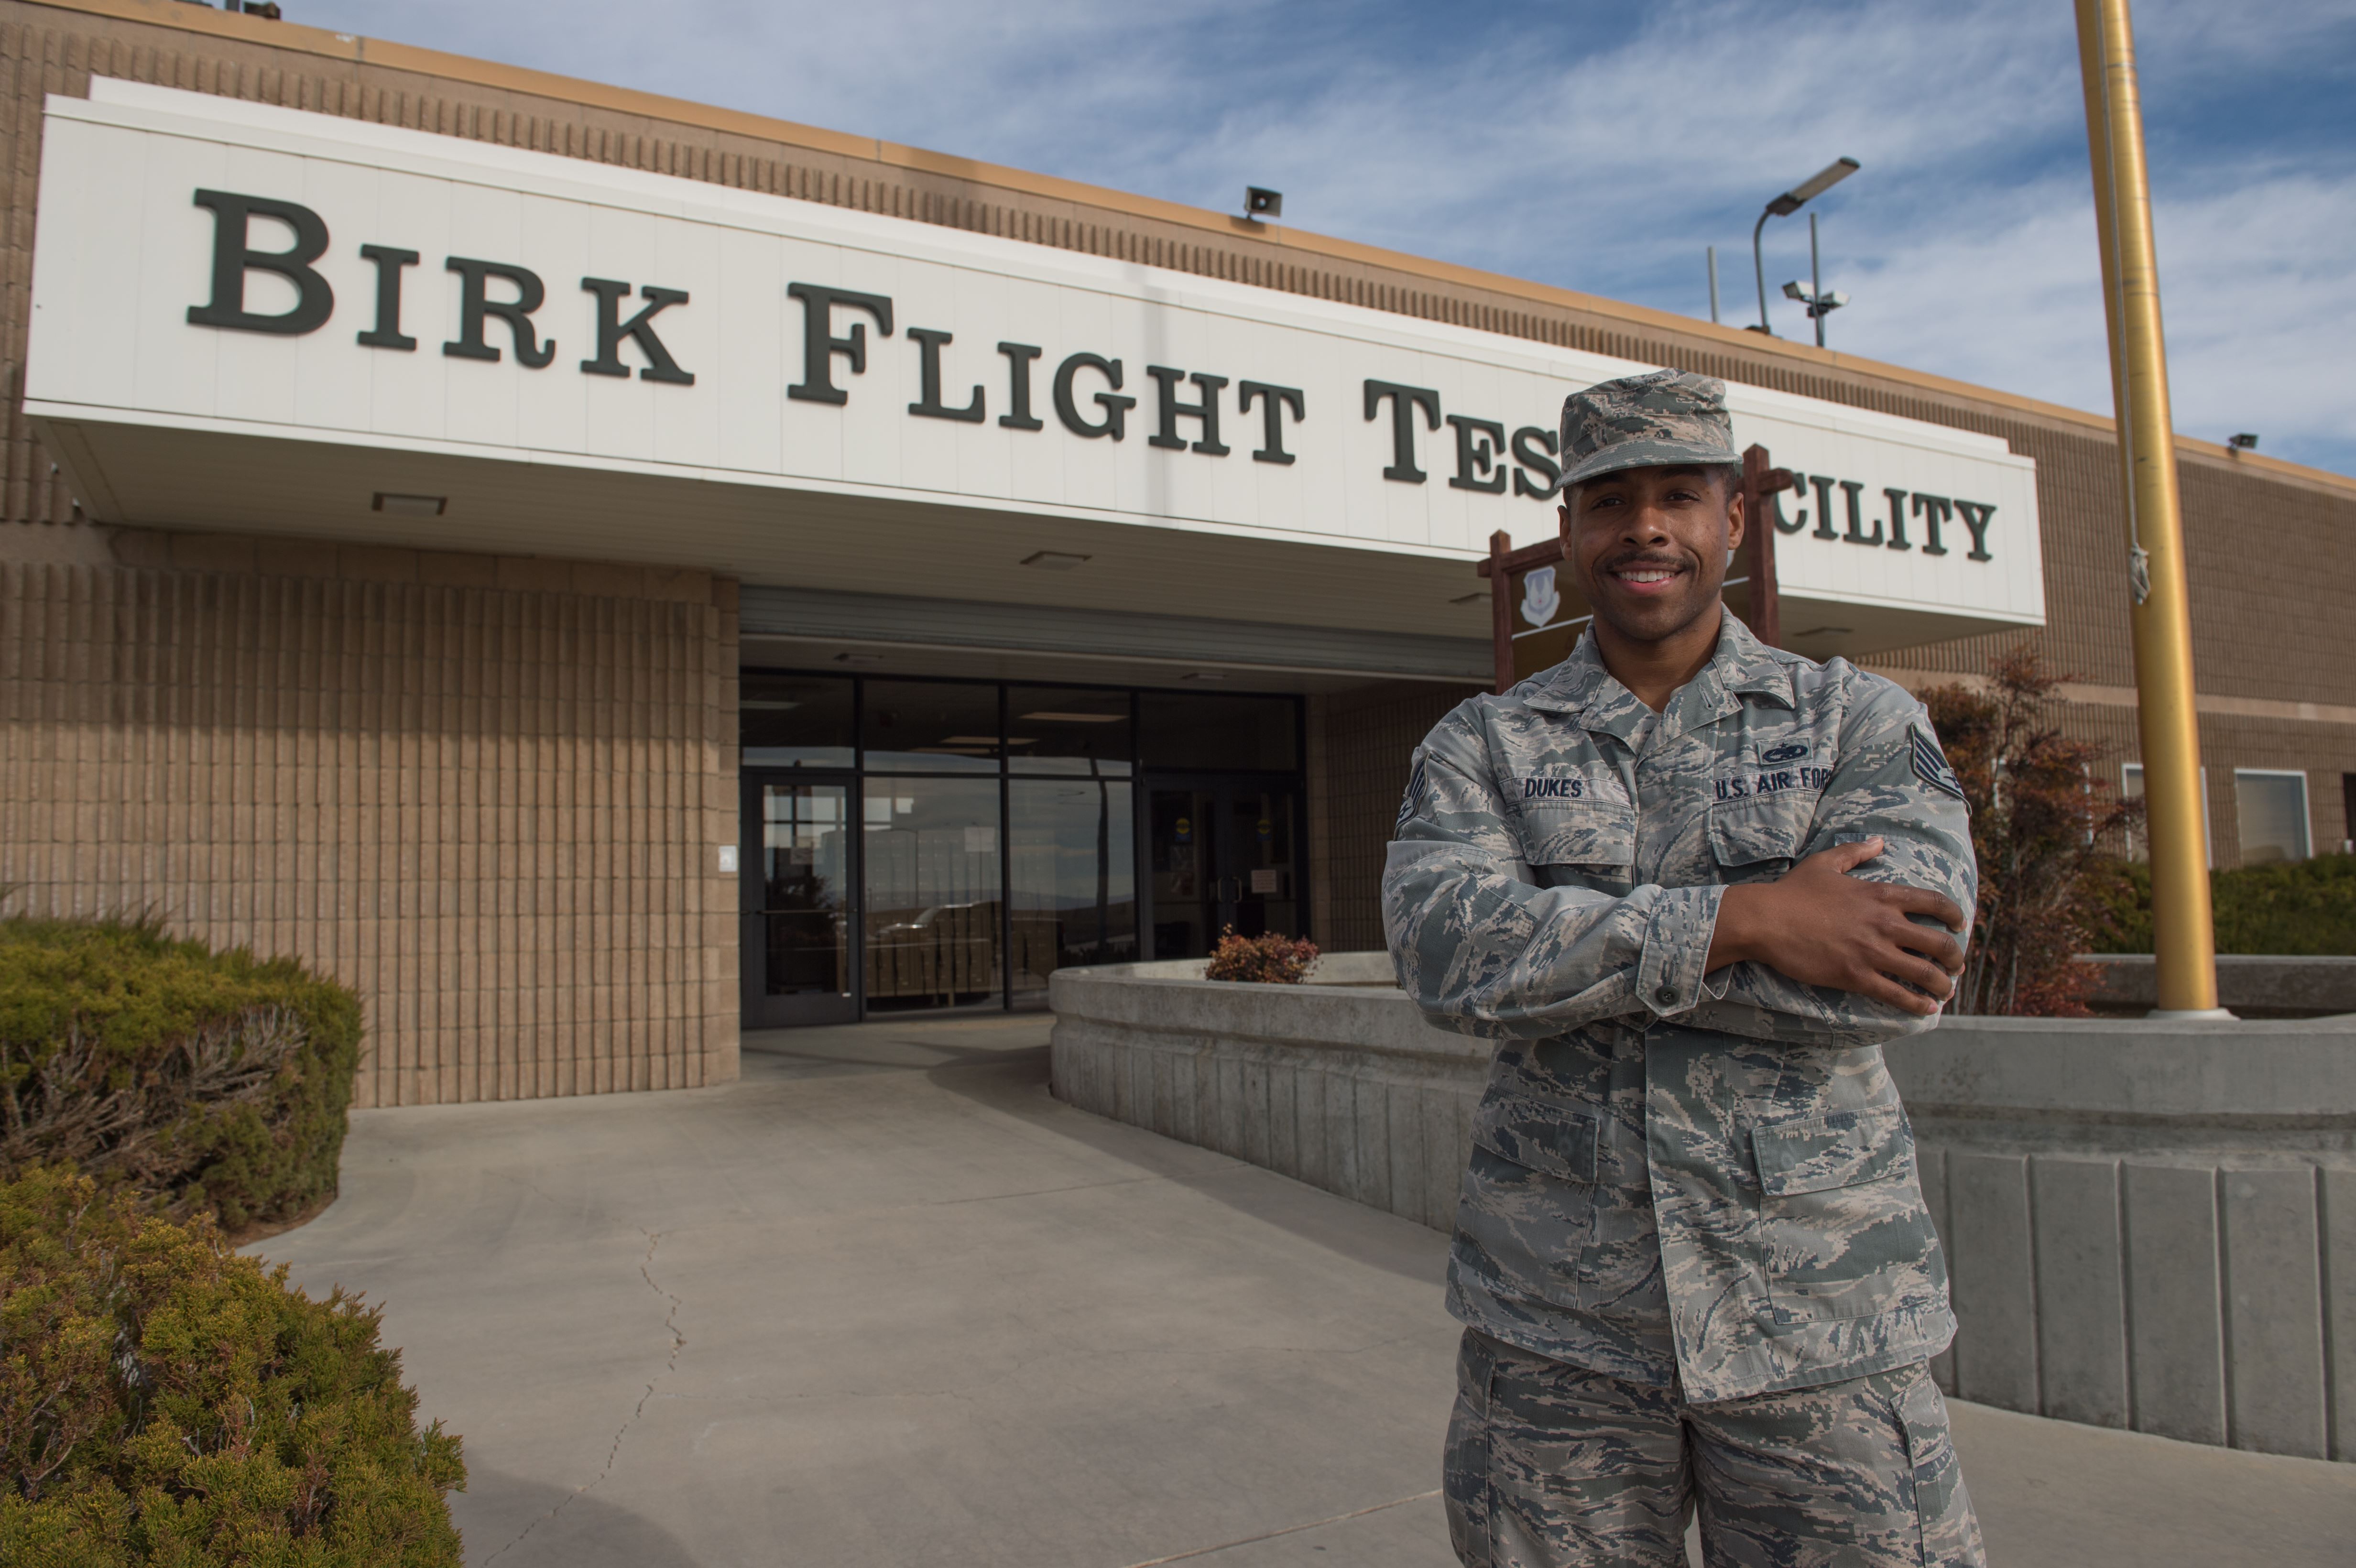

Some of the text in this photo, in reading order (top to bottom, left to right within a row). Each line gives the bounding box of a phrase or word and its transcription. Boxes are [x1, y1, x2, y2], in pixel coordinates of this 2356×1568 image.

[185, 187, 1997, 563] BIRK FLIGHT TES CILITY
[1525, 778, 1582, 798] DUKES
[1715, 767, 1832, 800] U.S. AIR FOR
